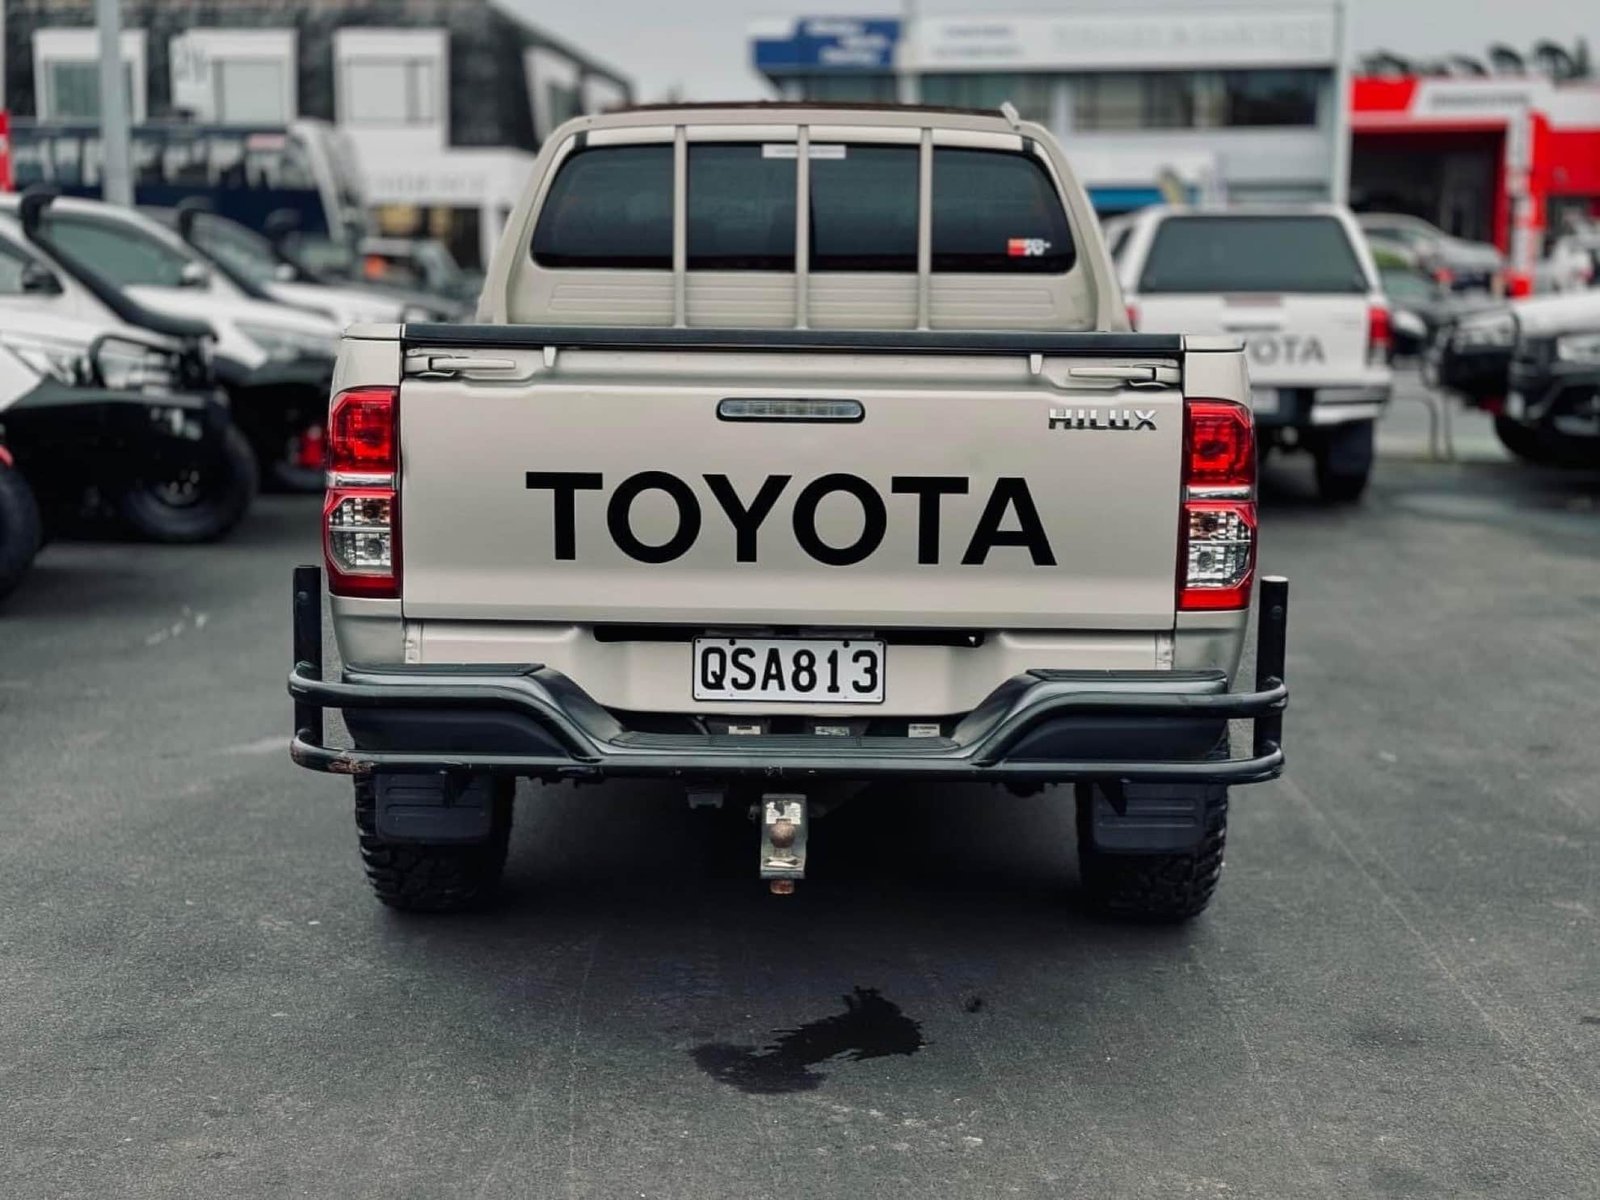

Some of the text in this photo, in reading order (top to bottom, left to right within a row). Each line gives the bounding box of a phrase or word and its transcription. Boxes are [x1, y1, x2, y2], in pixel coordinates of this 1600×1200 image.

[1048, 408, 1157, 431] HILUX
[525, 470, 1058, 567] TOYOTA
[700, 646, 879, 694] QSA813
